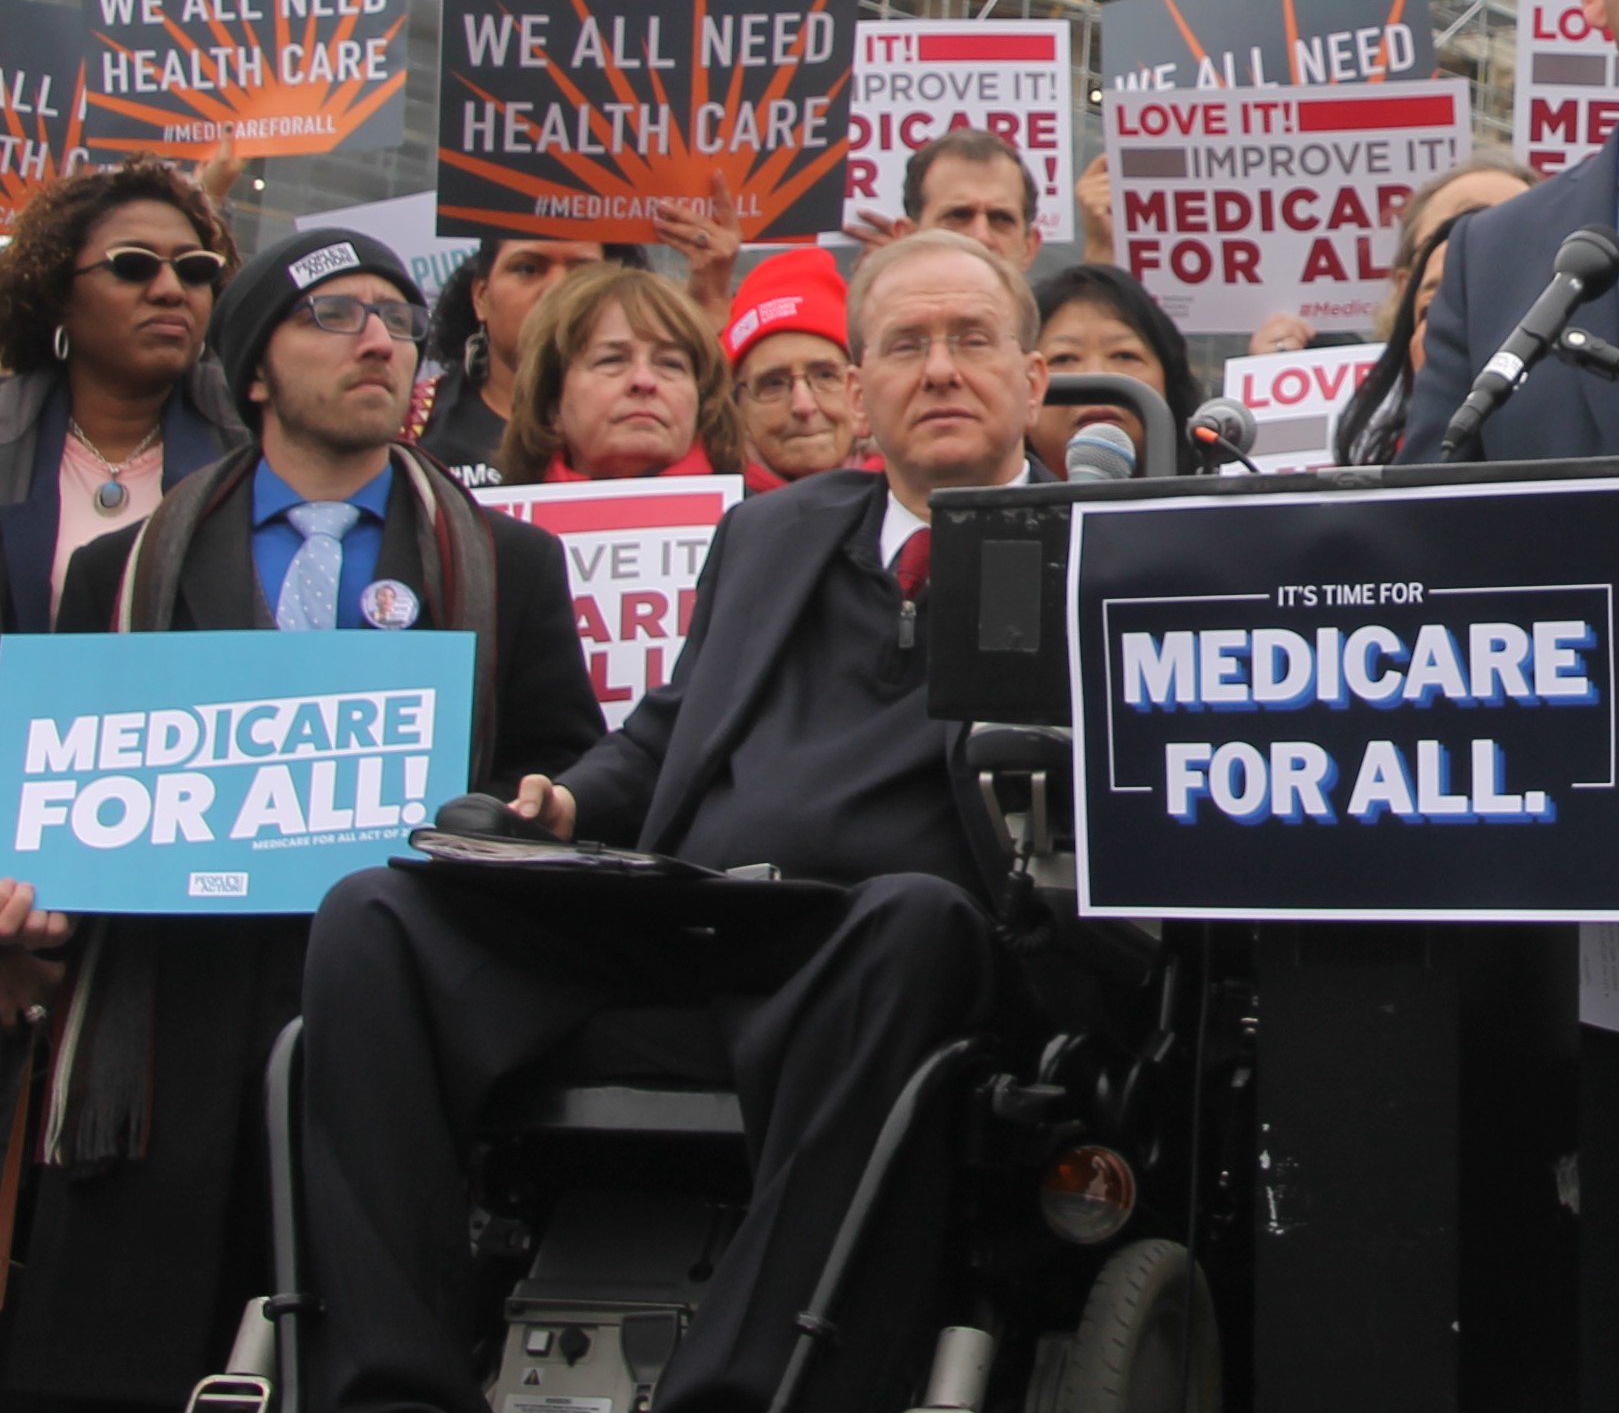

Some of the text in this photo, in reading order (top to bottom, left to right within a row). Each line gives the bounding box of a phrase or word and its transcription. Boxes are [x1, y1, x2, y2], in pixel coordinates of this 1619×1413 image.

[103, 38, 388, 93] HEALTH CARE
[463, 11, 834, 69] WE ALL NEED
[866, 35, 912, 63] IT!
[1294, 22, 1415, 84] NEED
[0, 67, 58, 118] LL
[1014, 71, 1057, 101] IT!
[463, 96, 829, 155] HEALTH CARE
[1116, 101, 1296, 136] LOVE IT!
[1193, 137, 1458, 179] IMPROVE IT!
[1129, 238, 1262, 284] FOR
[1277, 582, 1424, 607] IT'S TIME FOR
[1121, 620, 1598, 710] MEDICARE
[25, 694, 423, 774] MEDICARE
[15, 755, 430, 851] FOR ALL!
[1165, 738, 1556, 824] FOR ALL.
[252, 837, 310, 850] MEDICARE
[313, 834, 335, 846] FOR
[337, 833, 357, 843] ALL
[358, 831, 381, 842] ACT
